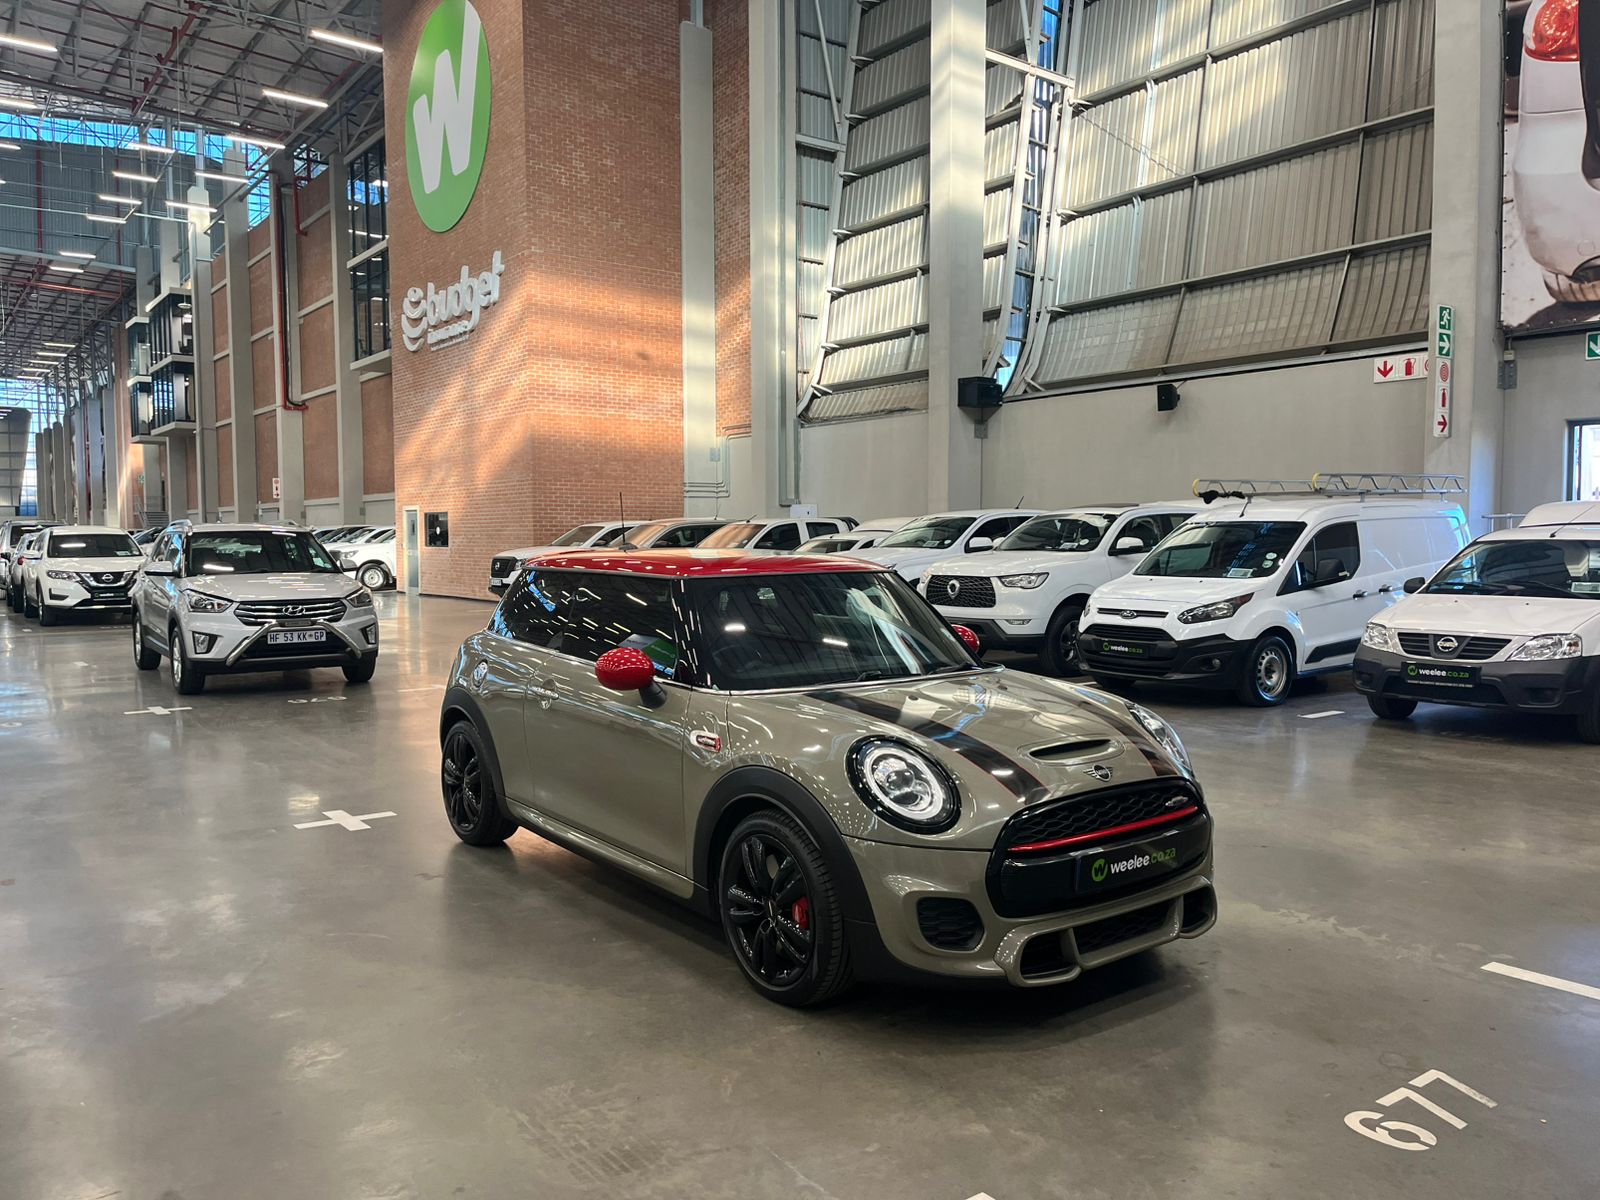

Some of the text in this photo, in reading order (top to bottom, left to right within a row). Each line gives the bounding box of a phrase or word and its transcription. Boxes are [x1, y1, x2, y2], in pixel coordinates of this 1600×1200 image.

[427, 250, 505, 332] budget
[283, 633, 294, 642] 53
[297, 632, 307, 641] KK
[314, 631, 324, 640] GP
[1419, 668, 1469, 678] weelee.co.za
[1110, 847, 1176, 874] weelee.co.za
[1343, 1069, 1498, 1151] 677
